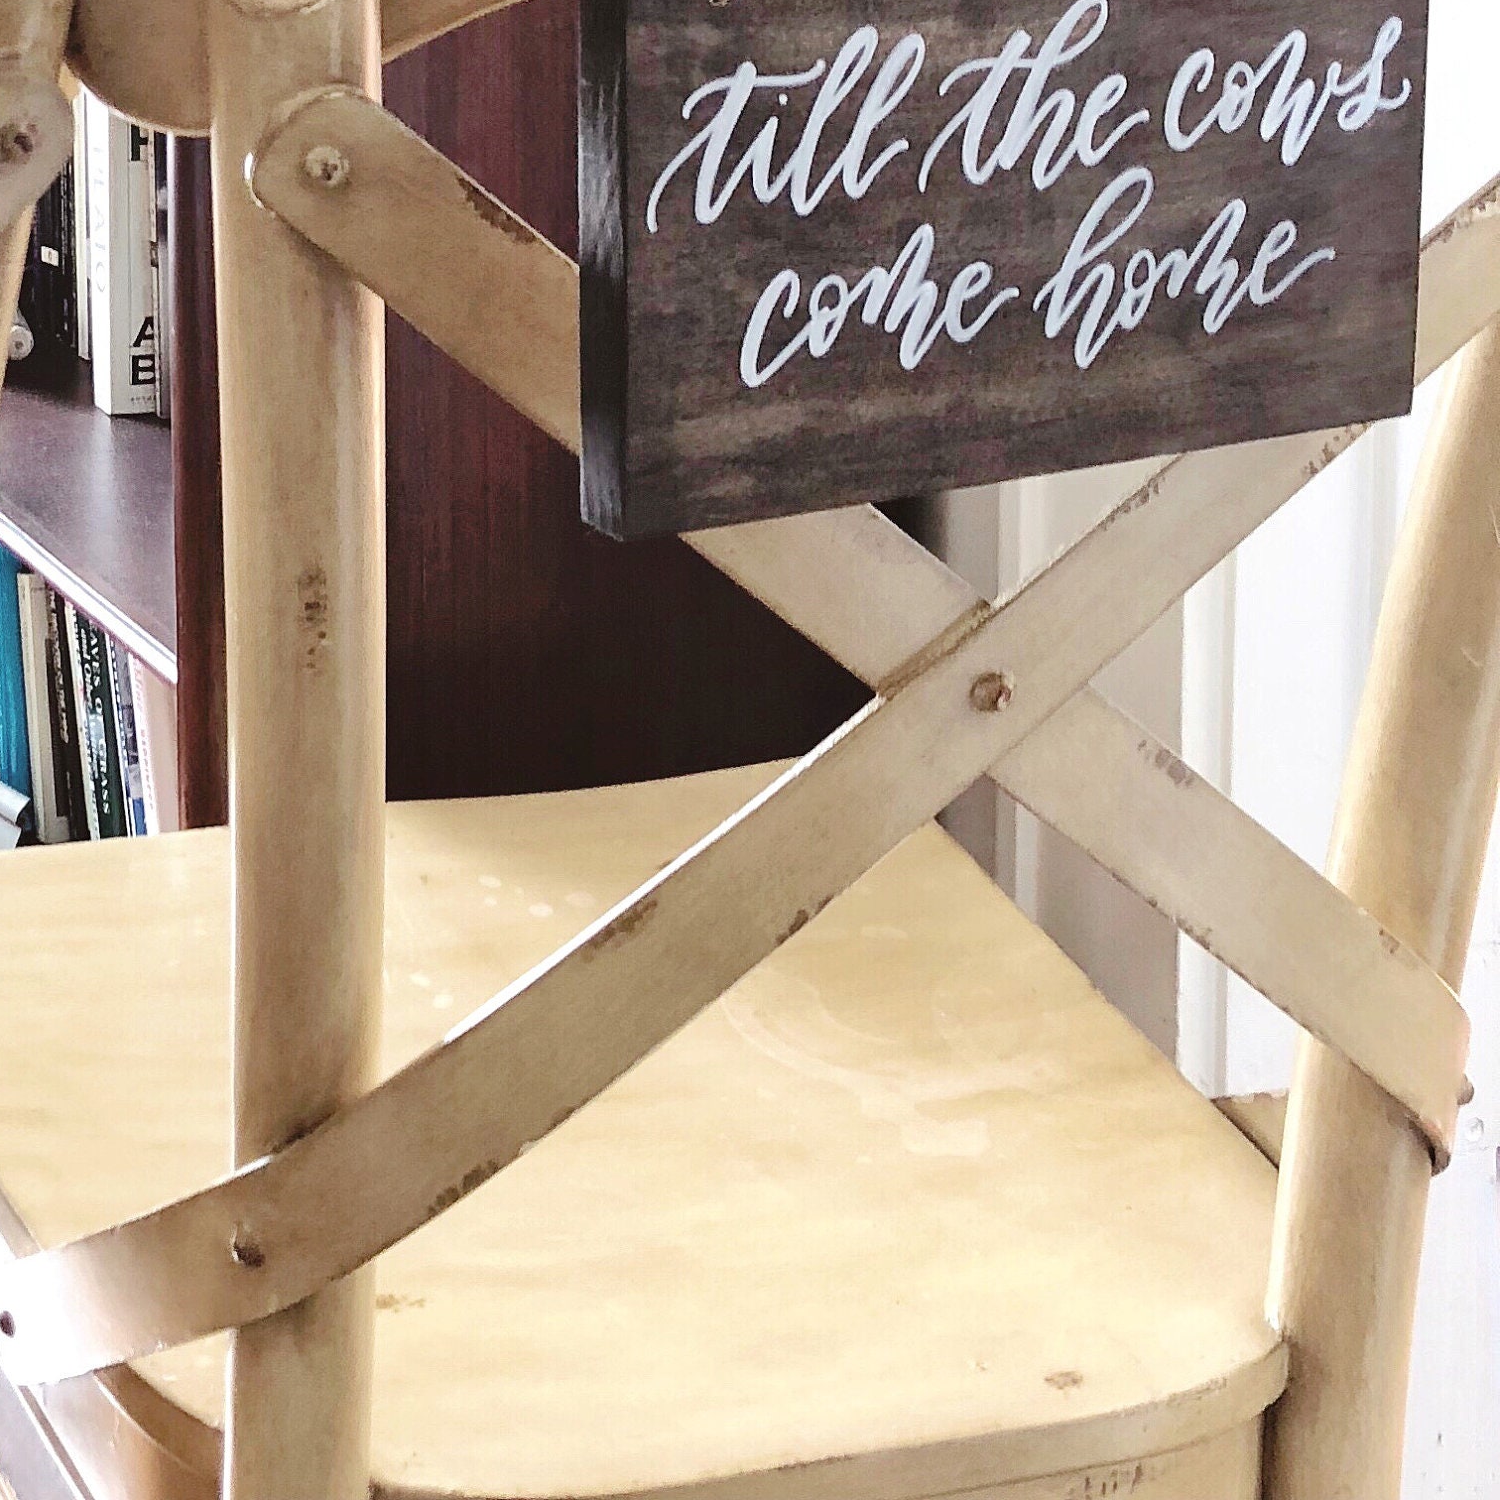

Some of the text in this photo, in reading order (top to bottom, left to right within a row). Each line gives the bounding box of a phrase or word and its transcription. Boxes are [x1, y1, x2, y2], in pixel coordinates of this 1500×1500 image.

[647, 22, 928, 234] till
[1163, 15, 1412, 166] cows
[739, 166, 1336, 388] come home
